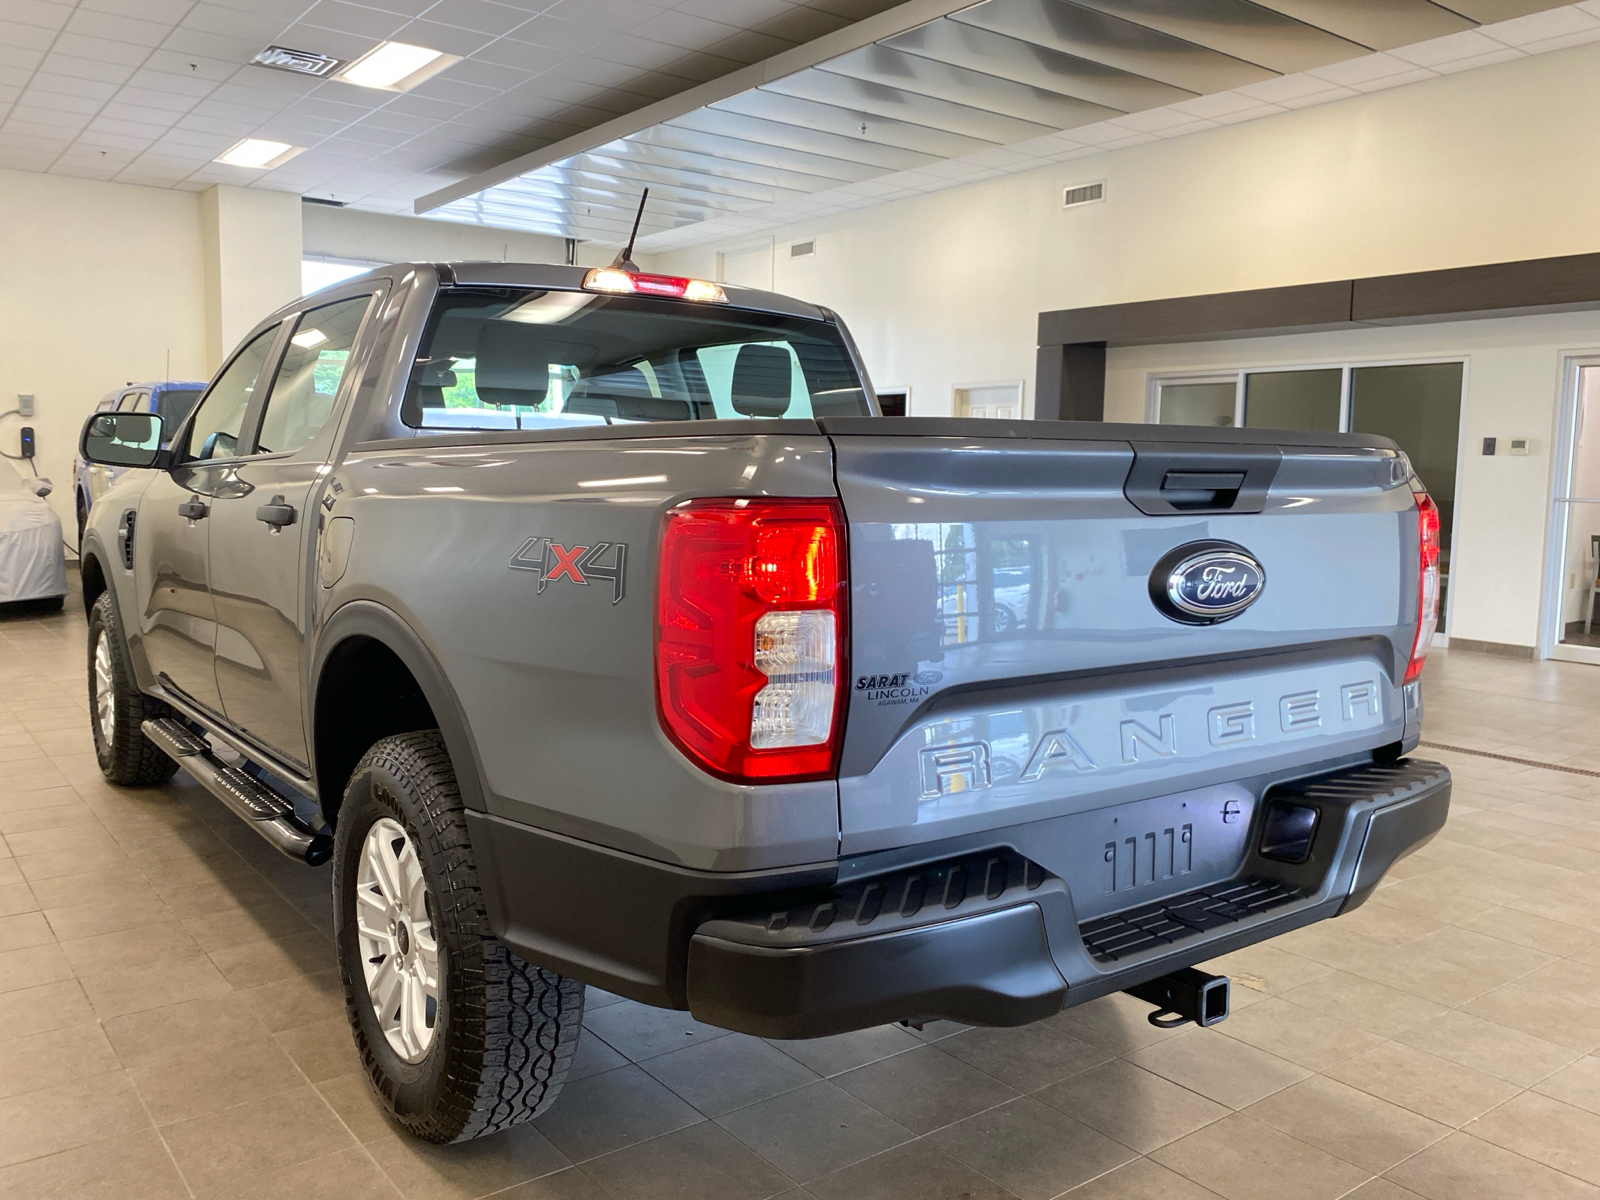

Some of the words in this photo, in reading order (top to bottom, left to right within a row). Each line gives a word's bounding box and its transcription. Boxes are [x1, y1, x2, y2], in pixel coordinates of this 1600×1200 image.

[1196, 566, 1248, 600] Ford
[855, 673, 910, 691] SARAT
[867, 686, 929, 700] LINCOLN
[918, 680, 1379, 799] RANGER
